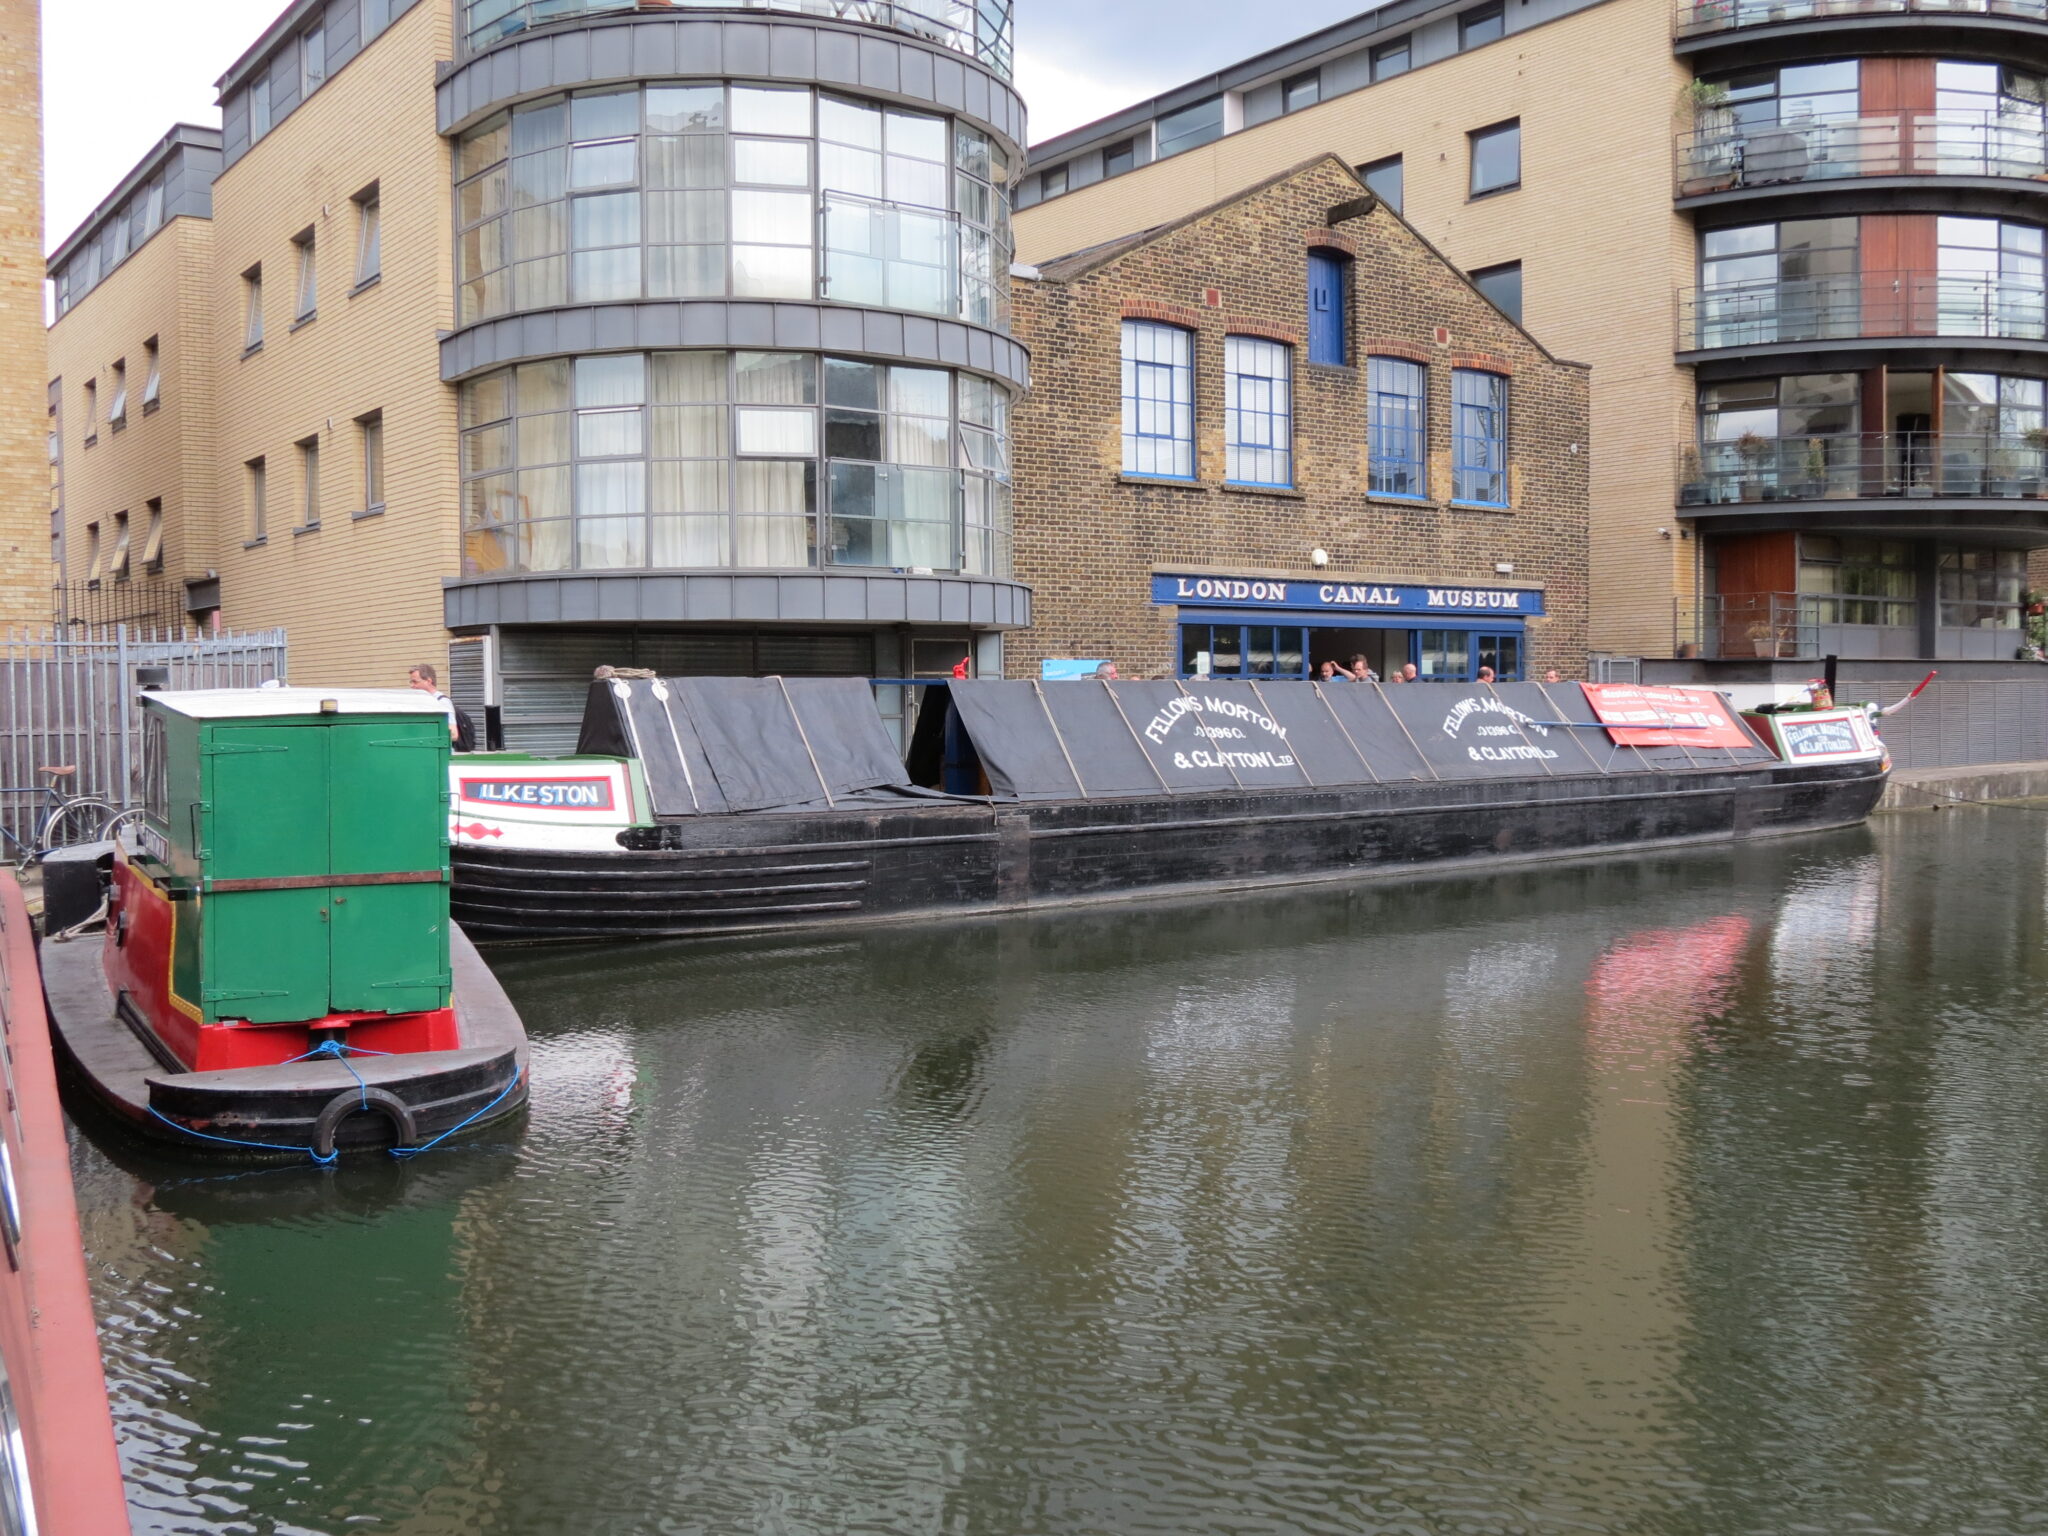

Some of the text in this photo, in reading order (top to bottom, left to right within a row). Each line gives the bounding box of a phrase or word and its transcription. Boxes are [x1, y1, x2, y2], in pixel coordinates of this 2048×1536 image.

[1177, 578, 1519, 608] LONDON CANAL MUSEUM
[1145, 696, 1287, 745] FELLOWS MORTON
[1174, 752, 1193, 769] &
[1192, 750, 1270, 768] CLAYTON
[1468, 746, 1483, 761] &
[480, 783, 599, 805] ILKESTON
